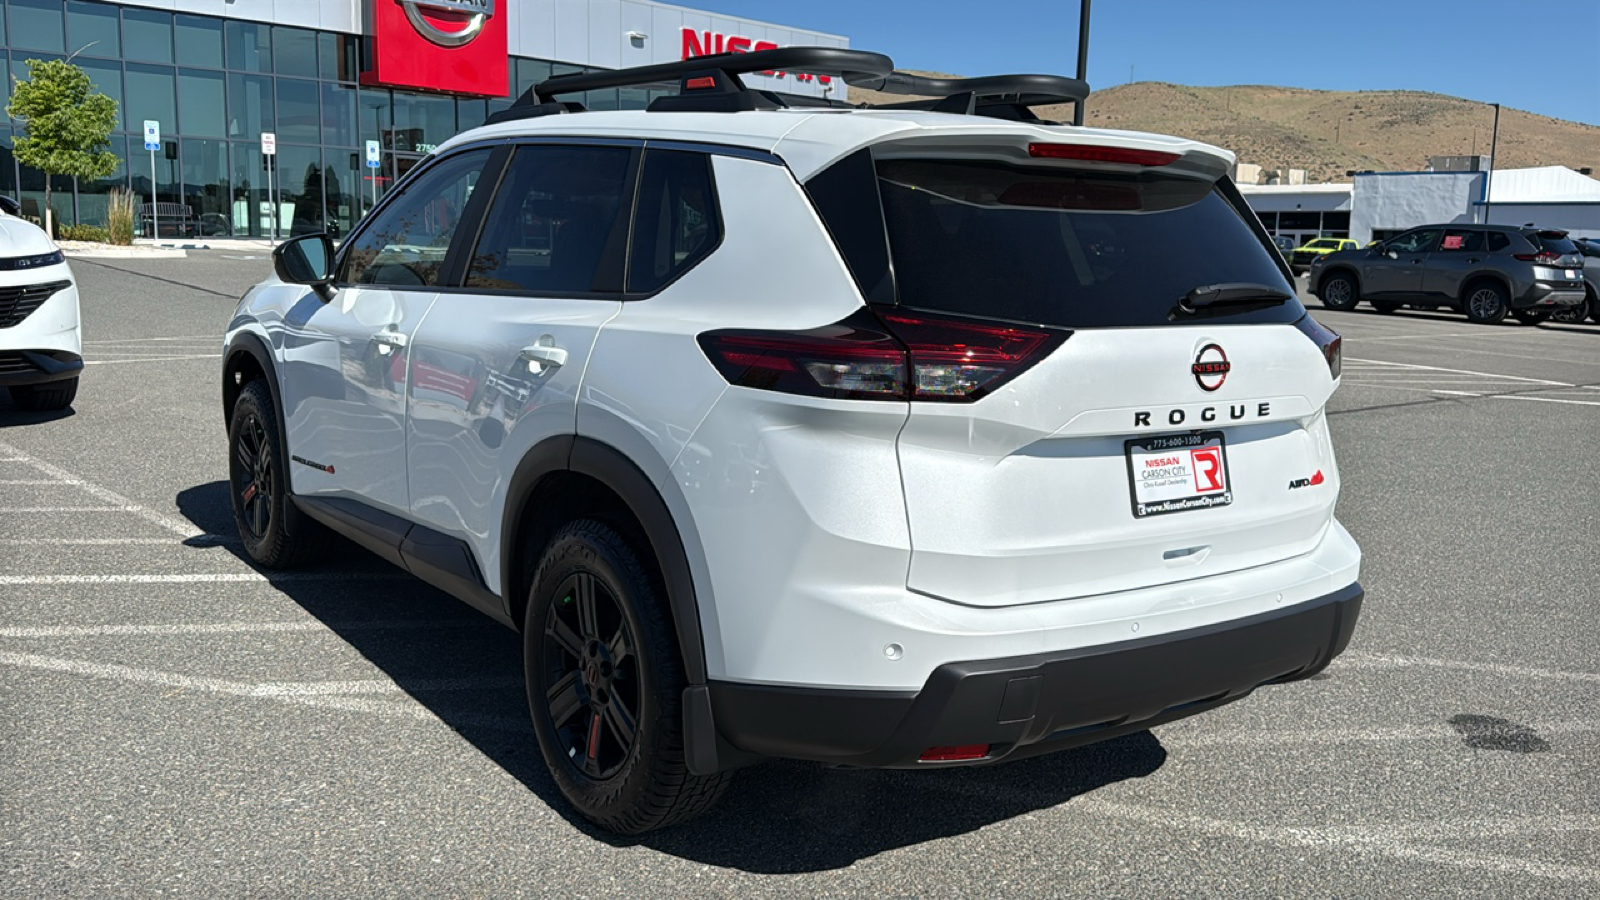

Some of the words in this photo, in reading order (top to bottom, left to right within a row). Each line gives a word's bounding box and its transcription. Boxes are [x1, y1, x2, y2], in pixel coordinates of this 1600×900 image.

[1193, 363, 1230, 372] NISSAN
[1134, 402, 1270, 427] ROGUE
[1153, 436, 1202, 448] 775-600-1500
[1145, 456, 1180, 468] NISSAN
[1141, 468, 1171, 480] CARSON
[1172, 466, 1186, 476] CITY
[1146, 496, 1225, 512] www.NissanCarsonCity.com
